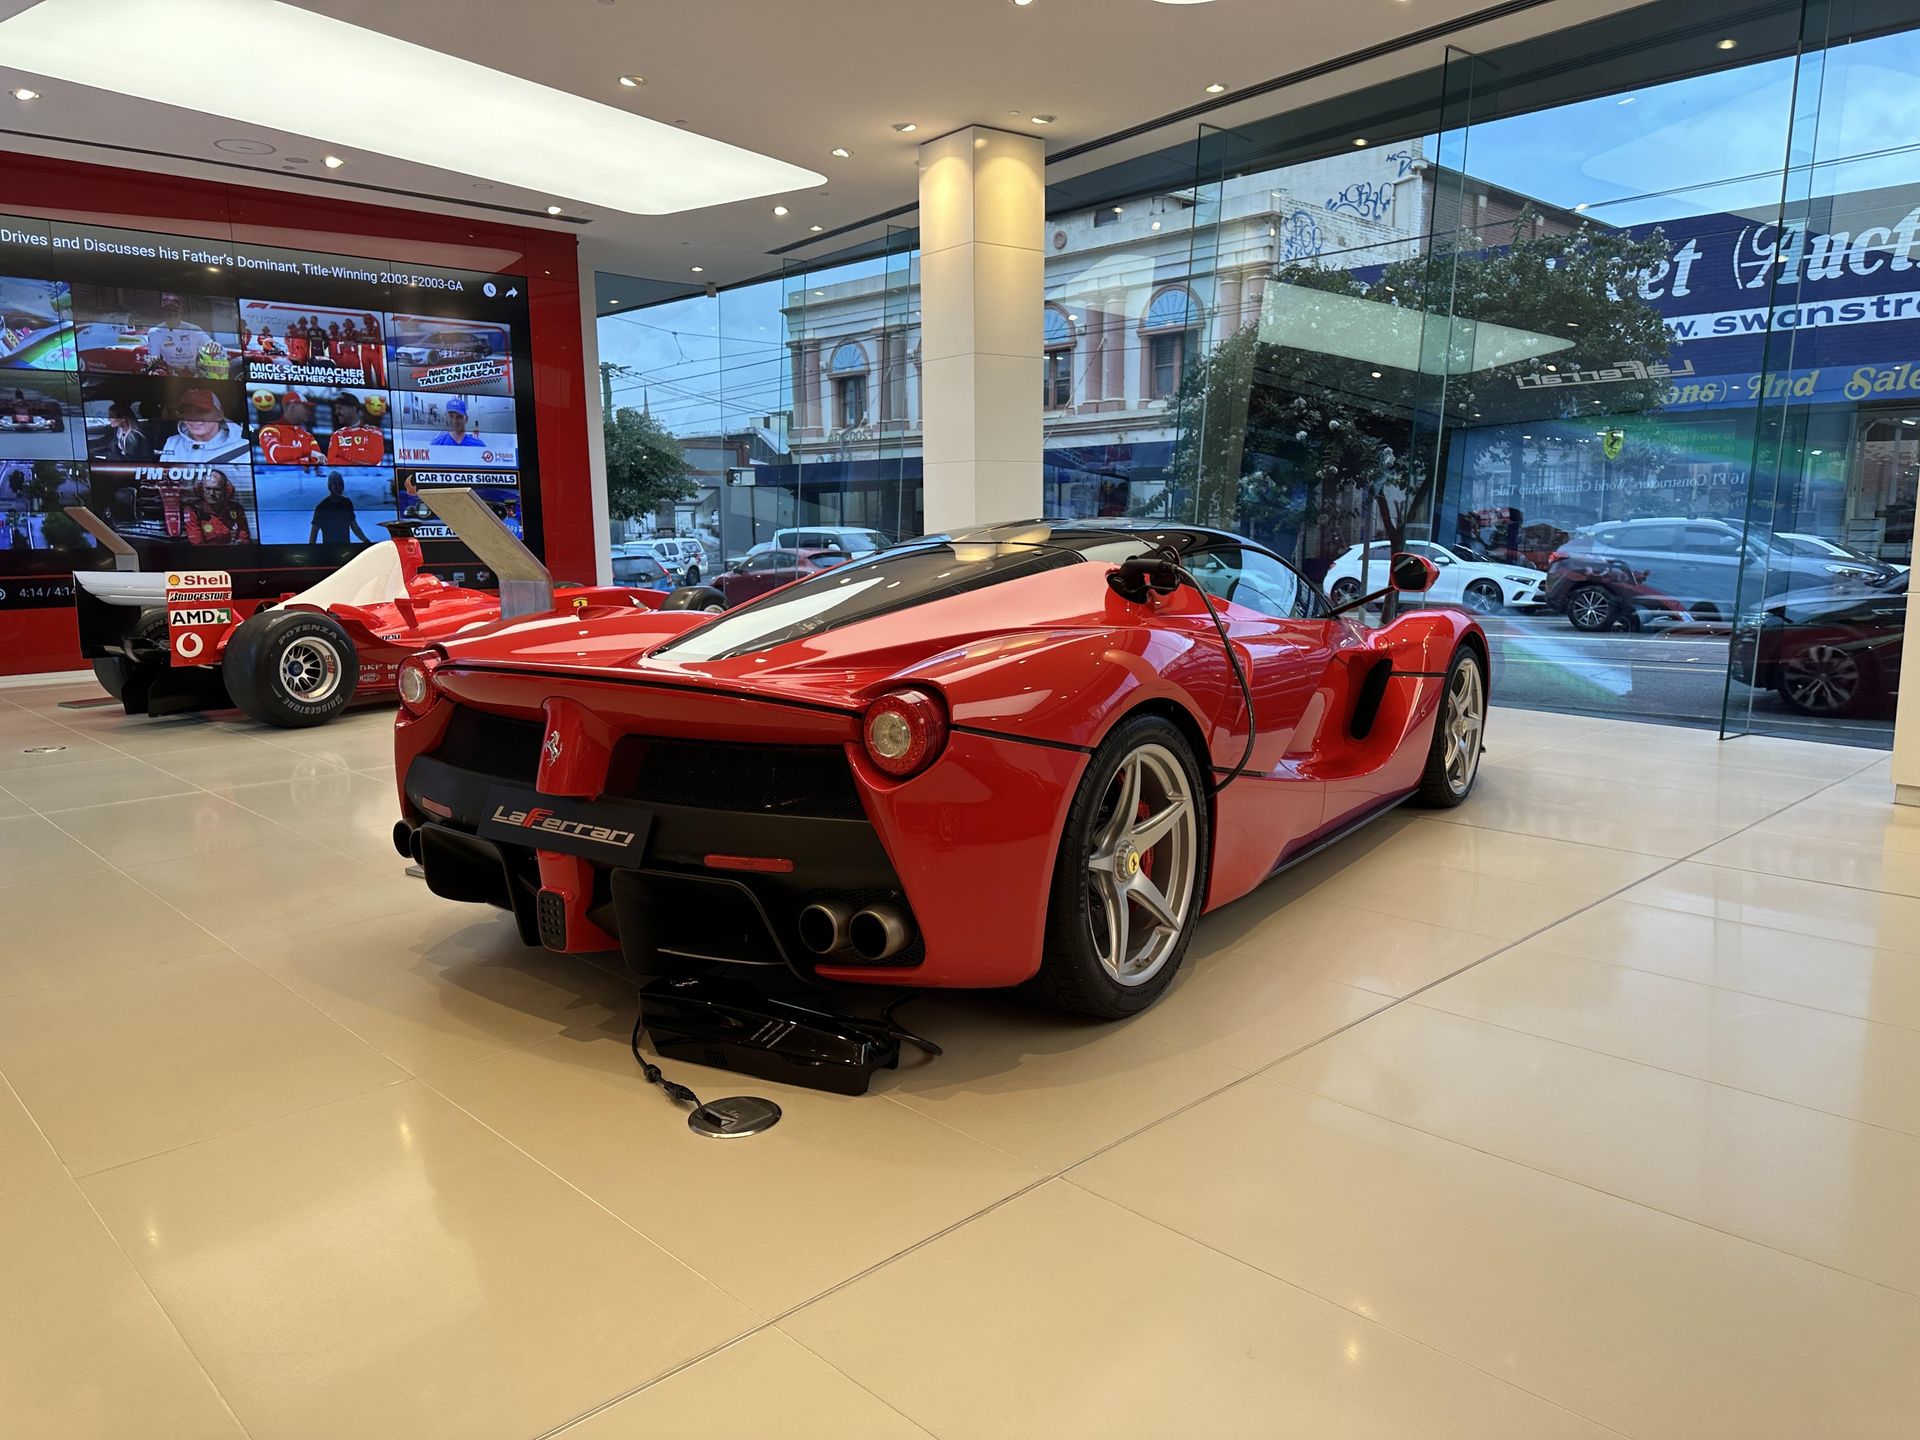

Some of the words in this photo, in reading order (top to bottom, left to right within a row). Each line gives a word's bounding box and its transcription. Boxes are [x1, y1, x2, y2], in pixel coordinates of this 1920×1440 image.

[1733, 205, 1920, 290] (Auct
[1, 229, 48, 246] Drives
[53, 236, 80, 250] and
[84, 238, 156, 258] Discusses
[159, 246, 179, 261] his
[183, 249, 234, 267] Father’s
[238, 255, 300, 277] Dominant,
[302, 263, 378, 284] Title-Winning
[381, 272, 409, 286] 2003
[412, 275, 464, 292] F2003-GA
[250, 362, 281, 373] MICK
[283, 365, 364, 378] SCHUMACHER
[420, 374, 446, 386] TAKE
[447, 372, 461, 381] ON
[462, 368, 502, 380] NASCAR
[429, 368, 452, 377] MICK
[454, 366, 461, 374] &
[462, 362, 493, 372] KEVIN
[250, 371, 287, 381] DRIVES
[288, 374, 334, 384] FATHER'S
[335, 376, 366, 385] F2004
[1747, 369, 1820, 401] And
[399, 448, 411, 460] ASK
[413, 449, 430, 461] MICK
[169, 467, 213, 481] OUT!
[418, 473, 438, 483] CAR
[440, 473, 452, 483] TO
[454, 473, 474, 483] CAR
[475, 474, 516, 484] SIGNALS
[412, 527, 443, 537] CTIVE
[184, 574, 229, 586] Shell
[19, 587, 43, 597] 4:14
[169, 591, 231, 602] BRIDGESTONE
[172, 610, 215, 625] AMD
[279, 623, 338, 646] POTENZA
[281, 693, 344, 716] BRIDGESTONE
[491, 804, 636, 847] LaFerrari
